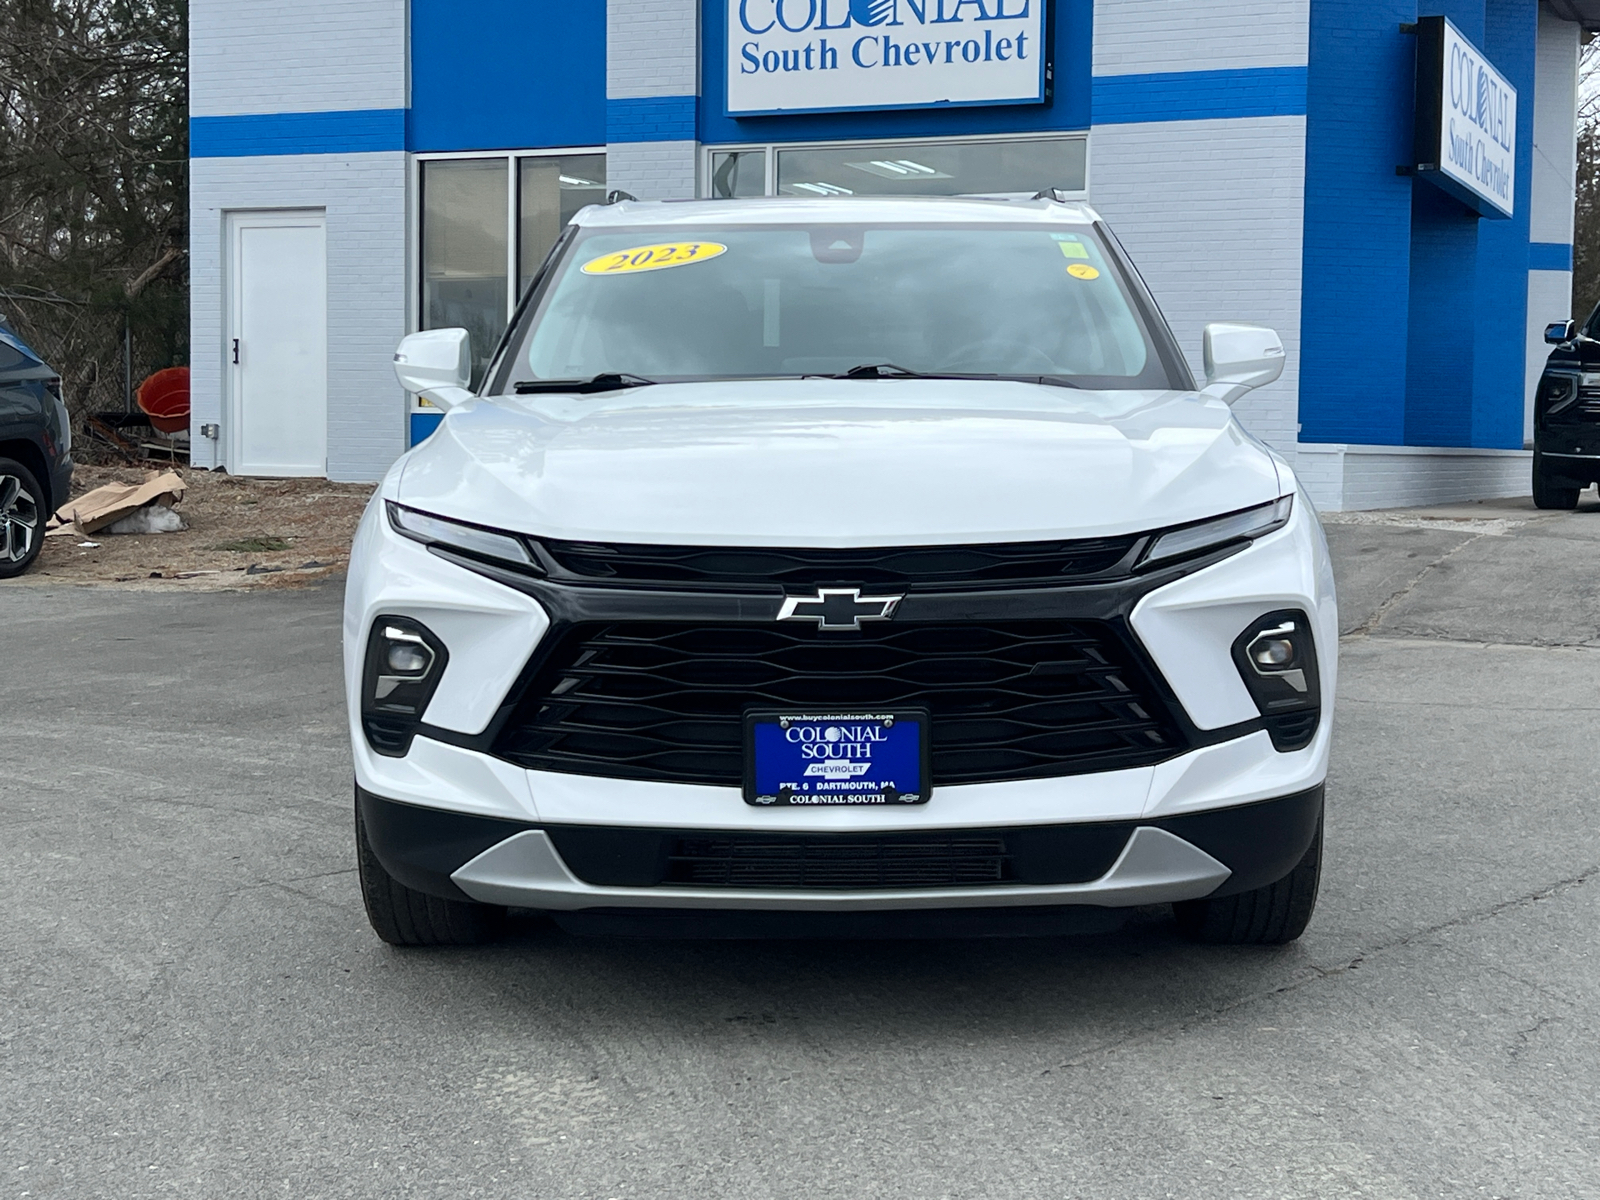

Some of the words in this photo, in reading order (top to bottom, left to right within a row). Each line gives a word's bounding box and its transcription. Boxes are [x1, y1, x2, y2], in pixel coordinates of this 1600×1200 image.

[740, 41, 839, 74] South
[851, 29, 1029, 68] Chevrolet
[1451, 42, 1511, 152] COLONIAL
[1449, 117, 1473, 175] South
[1475, 138, 1510, 200] Chevrolet
[605, 244, 701, 271] 2023
[779, 714, 894, 722] www.buycolonialsouth.com
[785, 726, 887, 743] COLONIAL
[801, 743, 872, 758] SOUTH
[811, 765, 864, 774] CHEVROLET
[802, 782, 809, 790] 6
[816, 781, 879, 791] DARTMOUTH,
[789, 795, 846, 804] COLONIAL
[847, 794, 886, 803] SOUTH
